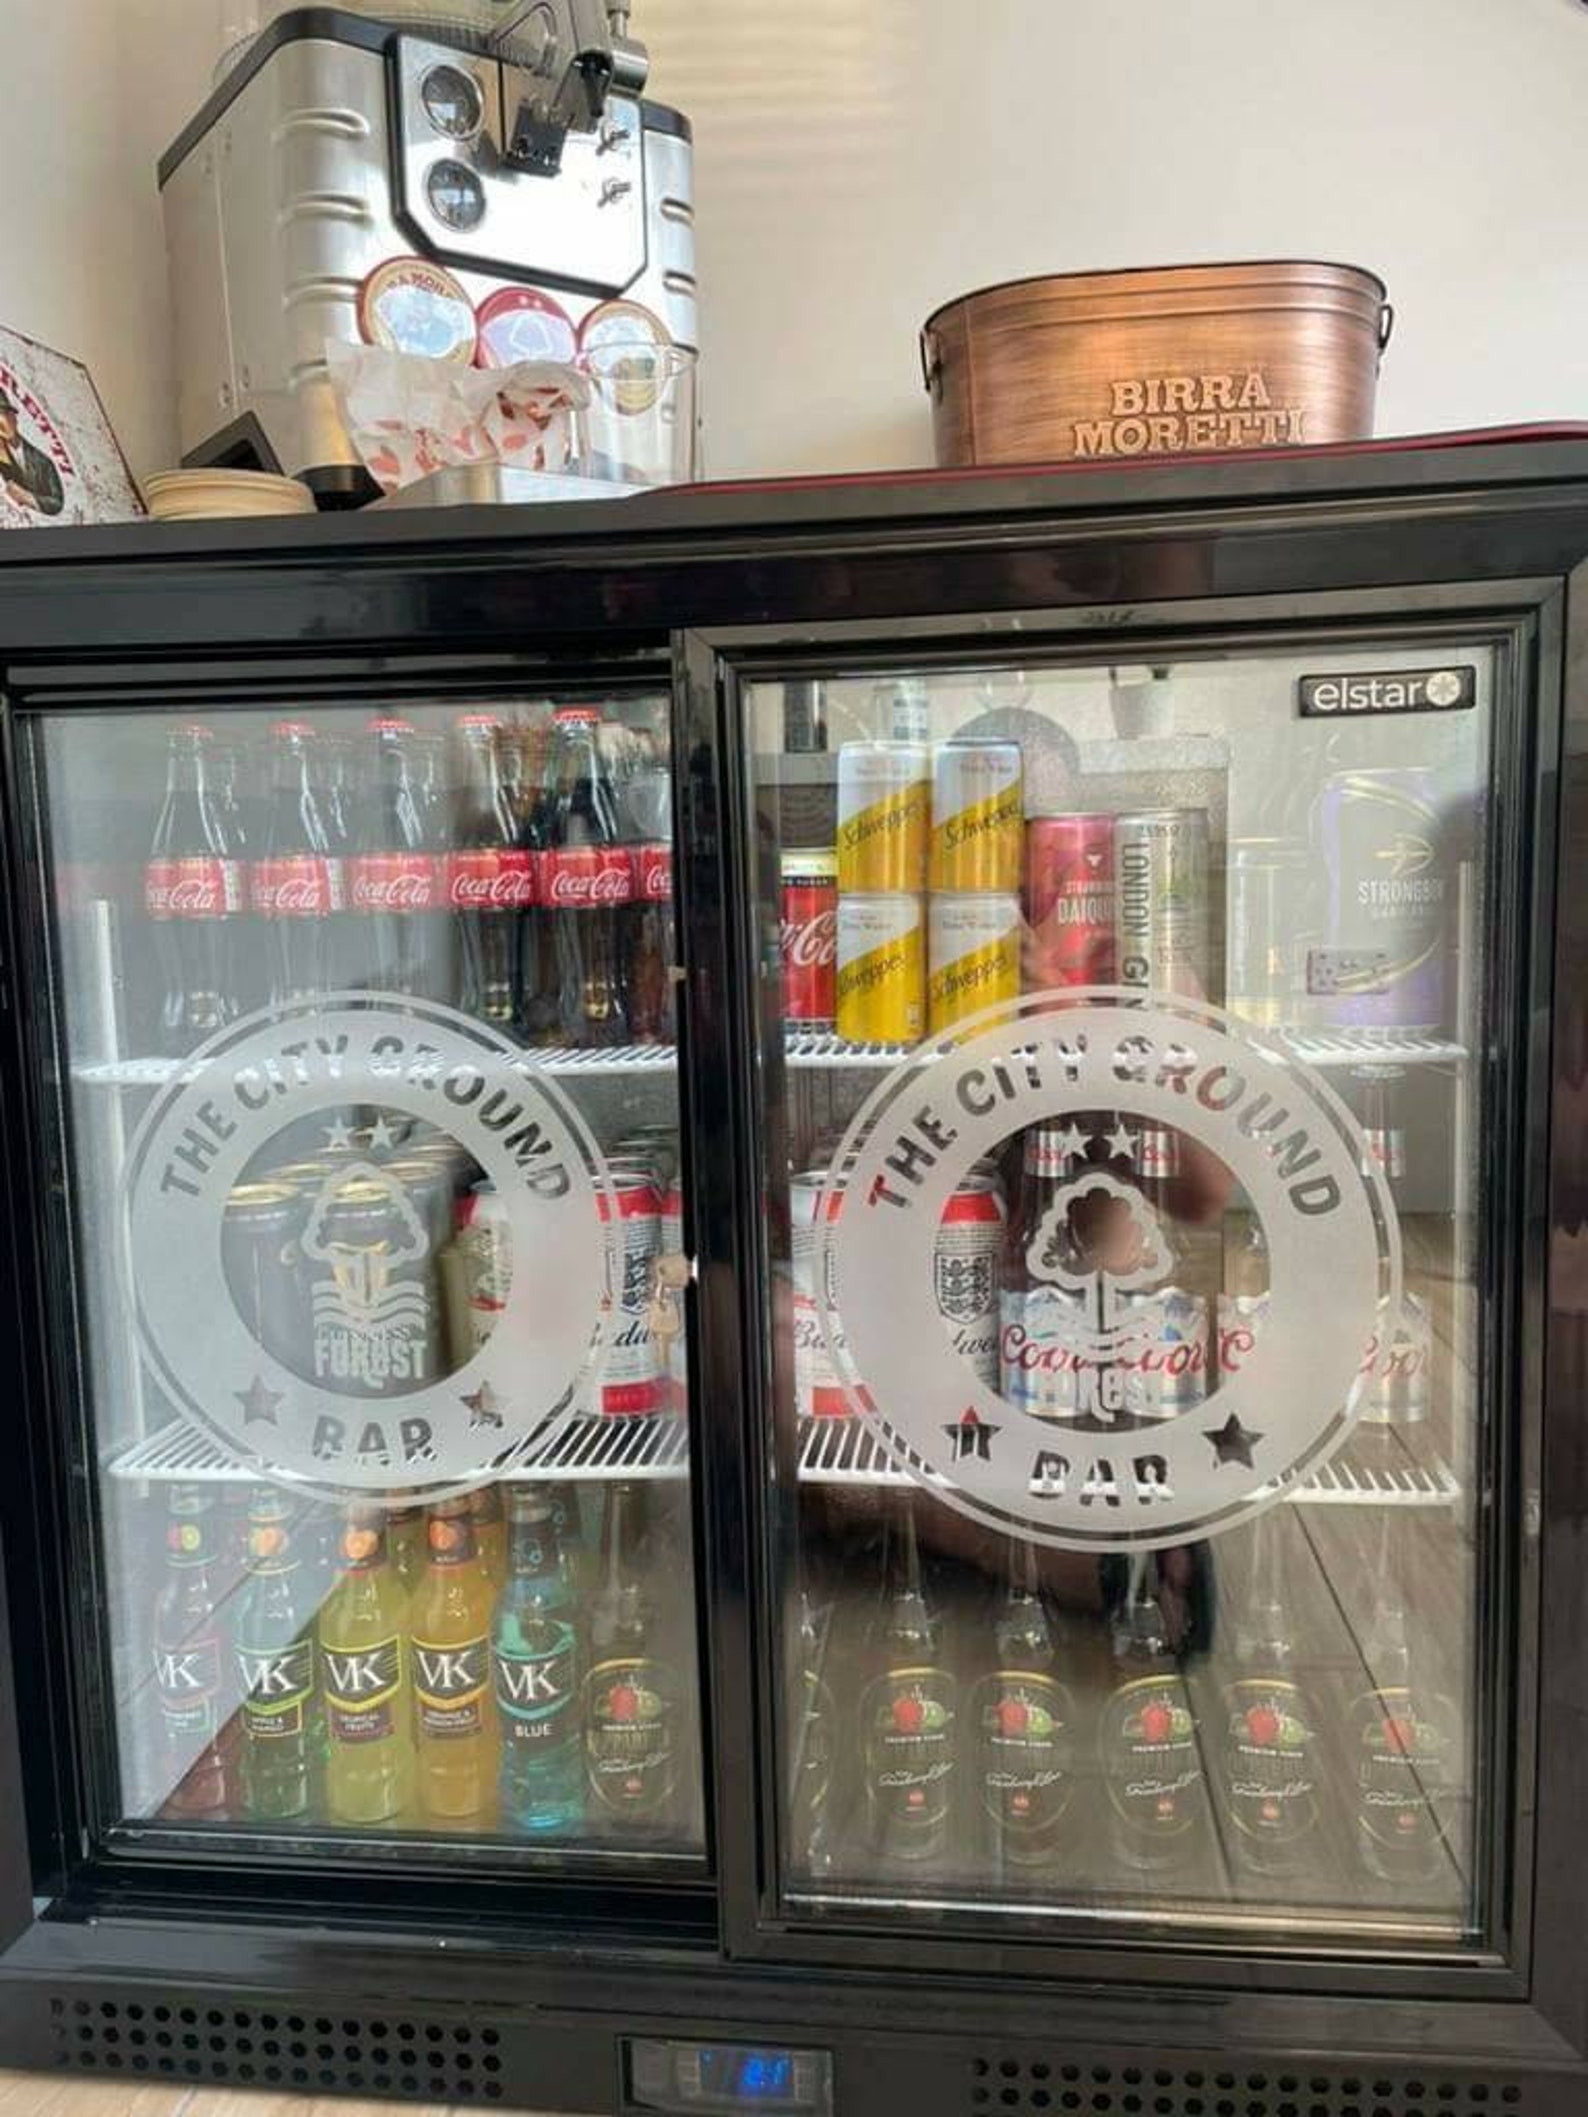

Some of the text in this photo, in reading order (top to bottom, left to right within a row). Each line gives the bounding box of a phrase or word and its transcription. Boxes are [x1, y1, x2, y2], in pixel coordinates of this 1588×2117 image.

[1111, 371, 1272, 416] BIRRA
[1070, 409, 1306, 457] MORETTI
[1313, 677, 1423, 711] elstar
[1122, 843, 1150, 938] LONDON
[161, 1034, 571, 1200] THE CITY GROUND
[868, 1032, 1342, 1217] THE CITY GROUND
[312, 1415, 438, 1465] BAR
[1028, 1450, 1175, 1508] BAR
[236, 1652, 299, 1694] VK
[325, 1651, 387, 1691] VK
[416, 1649, 476, 1688] VK
[499, 1659, 561, 1700] VK
[514, 1723, 553, 1738] BLUE
